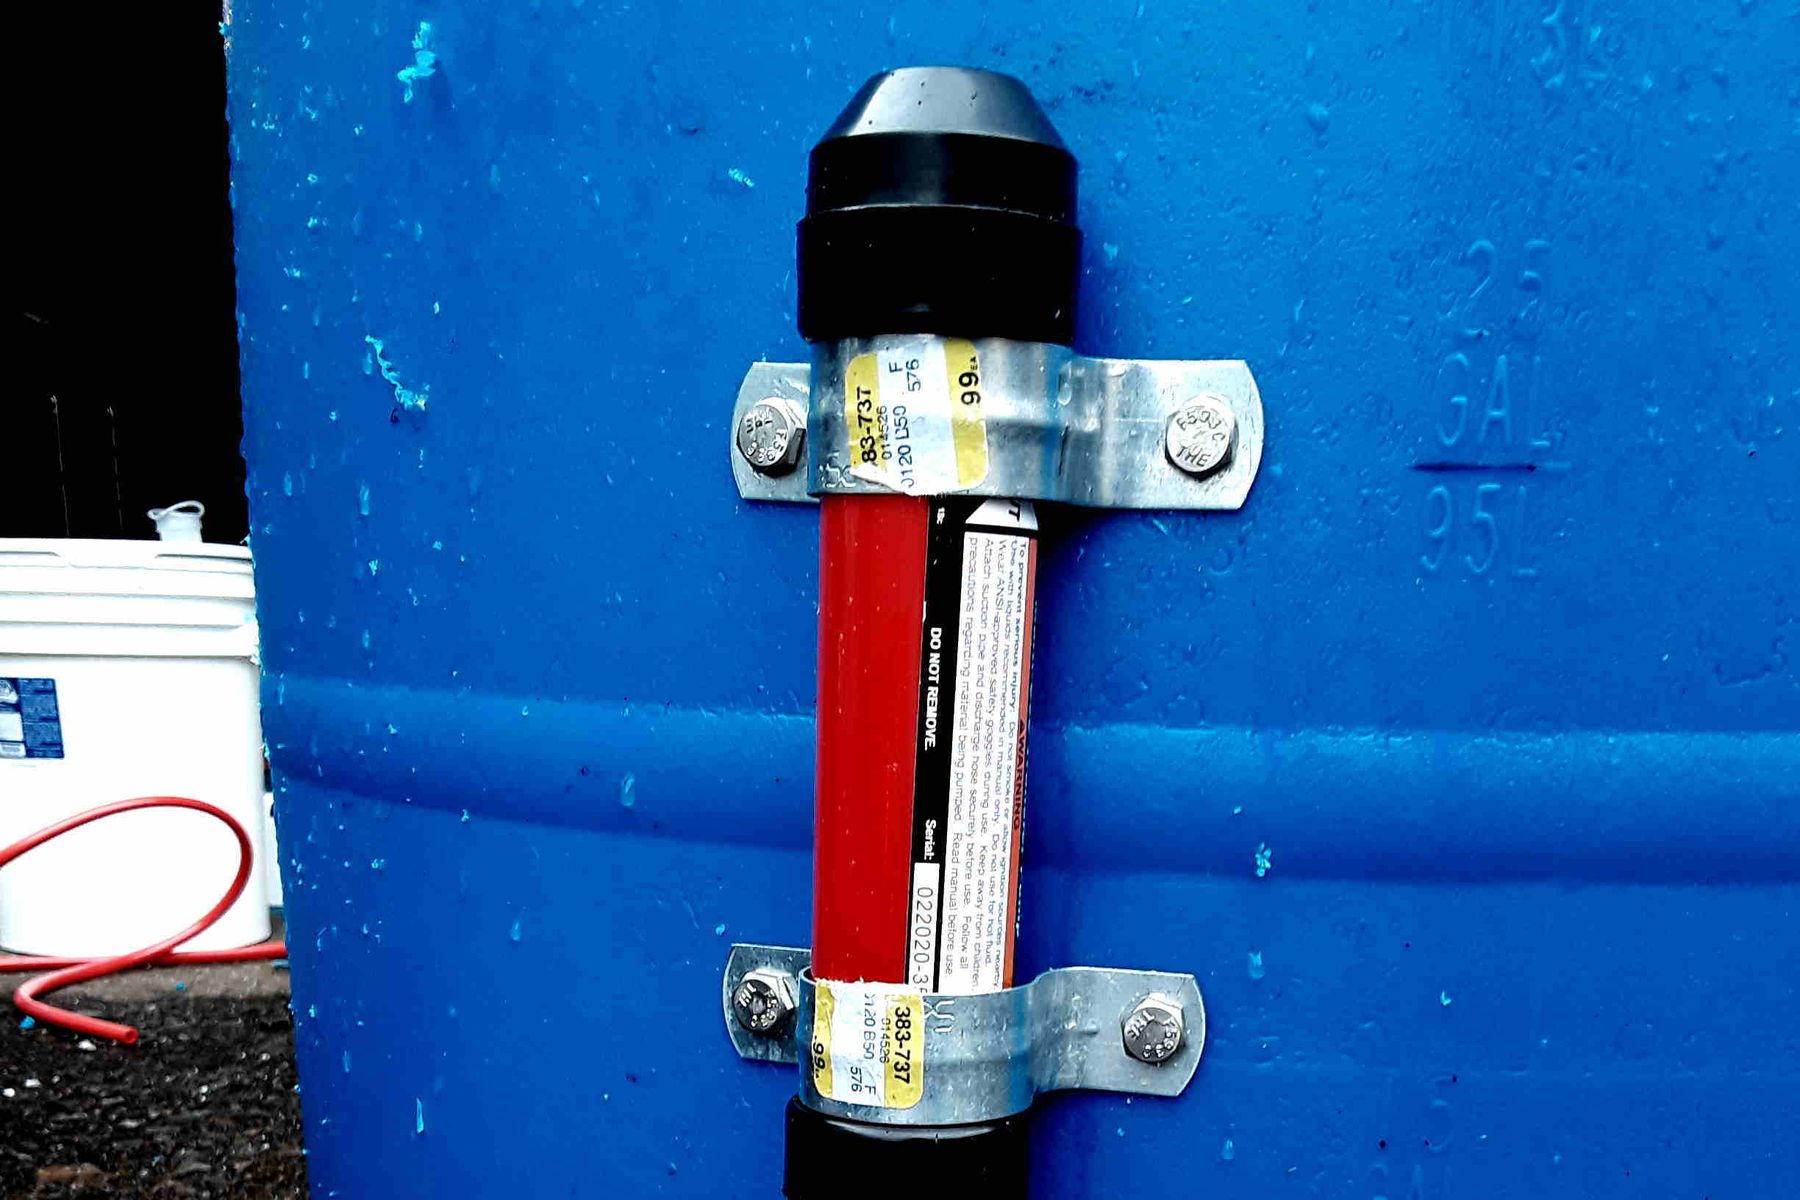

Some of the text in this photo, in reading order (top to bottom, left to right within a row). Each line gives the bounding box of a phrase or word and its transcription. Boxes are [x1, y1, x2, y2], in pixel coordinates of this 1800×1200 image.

[889, 362, 903, 373] F
[905, 359, 921, 391] 576
[1434, 351, 1552, 450] GAL
[857, 386, 877, 467] 83-737
[1416, 481, 1544, 579] 95L
[984, 538, 994, 579] Attach
[997, 539, 1007, 573] Wear
[1019, 542, 1026, 558] To
[966, 537, 978, 612] precautions
[1007, 571, 1016, 595] with
[1015, 562, 1024, 613] prevent
[980, 584, 991, 629] suction
[1004, 600, 1014, 639] liquids
[930, 627, 942, 649] DO
[989, 578, 1005, 674] ANSI-approved
[1013, 618, 1021, 667] serious
[960, 617, 975, 677] regarding
[977, 634, 987, 660] pipe
[928, 652, 941, 684] NOT
[976, 664, 985, 688] and
[959, 681, 970, 730] material
[988, 680, 998, 714] safety
[999, 645, 1011, 732] recommended
[972, 692, 984, 751] discharge
[1009, 721, 1016, 736] Do
[954, 735, 967, 768] being
[984, 720, 995, 766] goggles
[971, 756, 980, 784] hose
[995, 752, 1004, 795] manual
[1004, 765, 1012, 803] smoke
[1014, 736, 1025, 830] WARNING
[981, 772, 992, 808] during
[965, 789, 977, 838] securely
[1004, 808, 1010, 819] or
[924, 819, 936, 861] Serial:
[952, 833, 962, 863] Read
[991, 834, 999, 850] Do
[965, 842, 975, 880] before
[978, 846, 988, 875] Keep
[990, 855, 998, 872] not
[998, 857, 1006, 898] ignition
[949, 868, 960, 910] manual
[975, 880, 985, 909] away
[988, 901, 996, 914] for
[996, 902, 1004, 945] sources
[947, 914, 958, 951] before
[961, 916, 972, 952] Follow
[975, 913, 984, 939] from
[987, 919, 995, 936] hot
[960, 956, 969, 969] all
[879, 1018, 891, 1064] 014526
[894, 1006, 911, 1084] 383-737
[850, 1066, 862, 1092] 576
[864, 1085, 876, 1095] F
